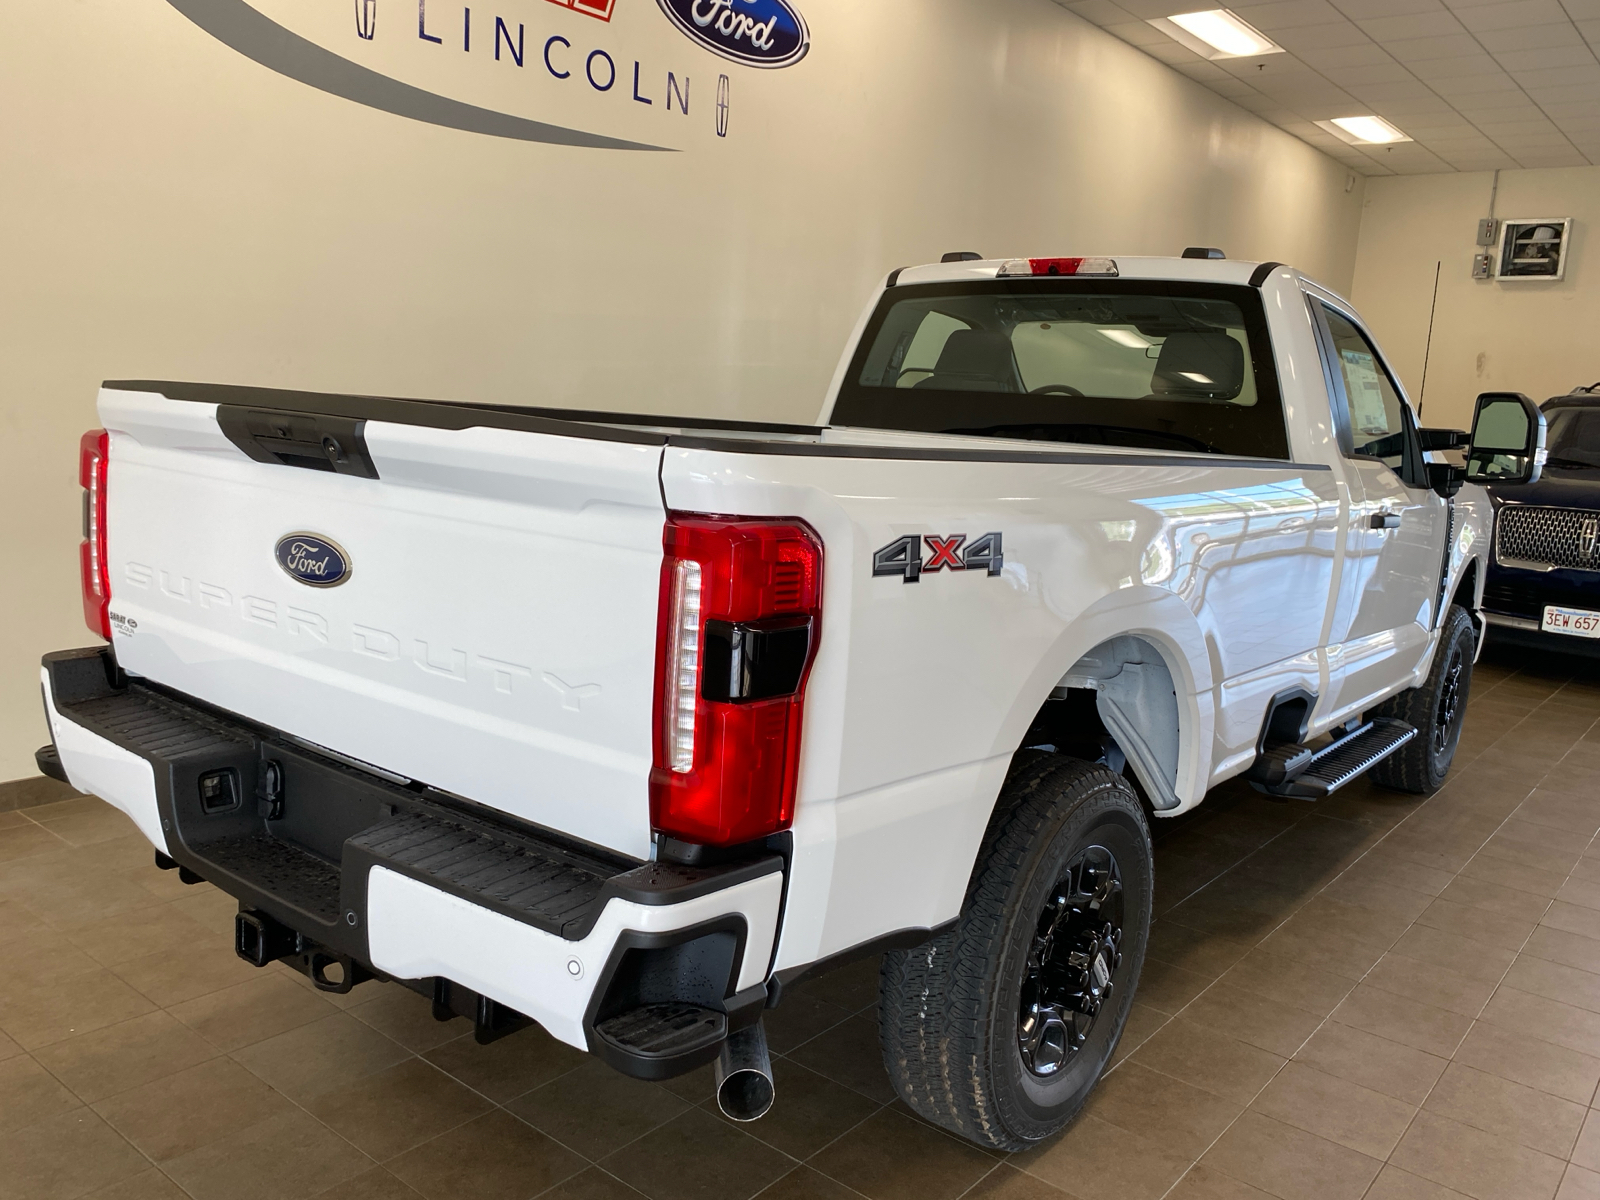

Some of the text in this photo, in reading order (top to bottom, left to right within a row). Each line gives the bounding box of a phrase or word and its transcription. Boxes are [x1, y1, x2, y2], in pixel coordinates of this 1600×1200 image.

[418, 0, 690, 116] LINCOLN
[287, 541, 329, 577] Ford
[126, 561, 602, 713] SUPER DUTY
[1545, 612, 1571, 628] 3EW
[1574, 616, 1600, 632] 657
